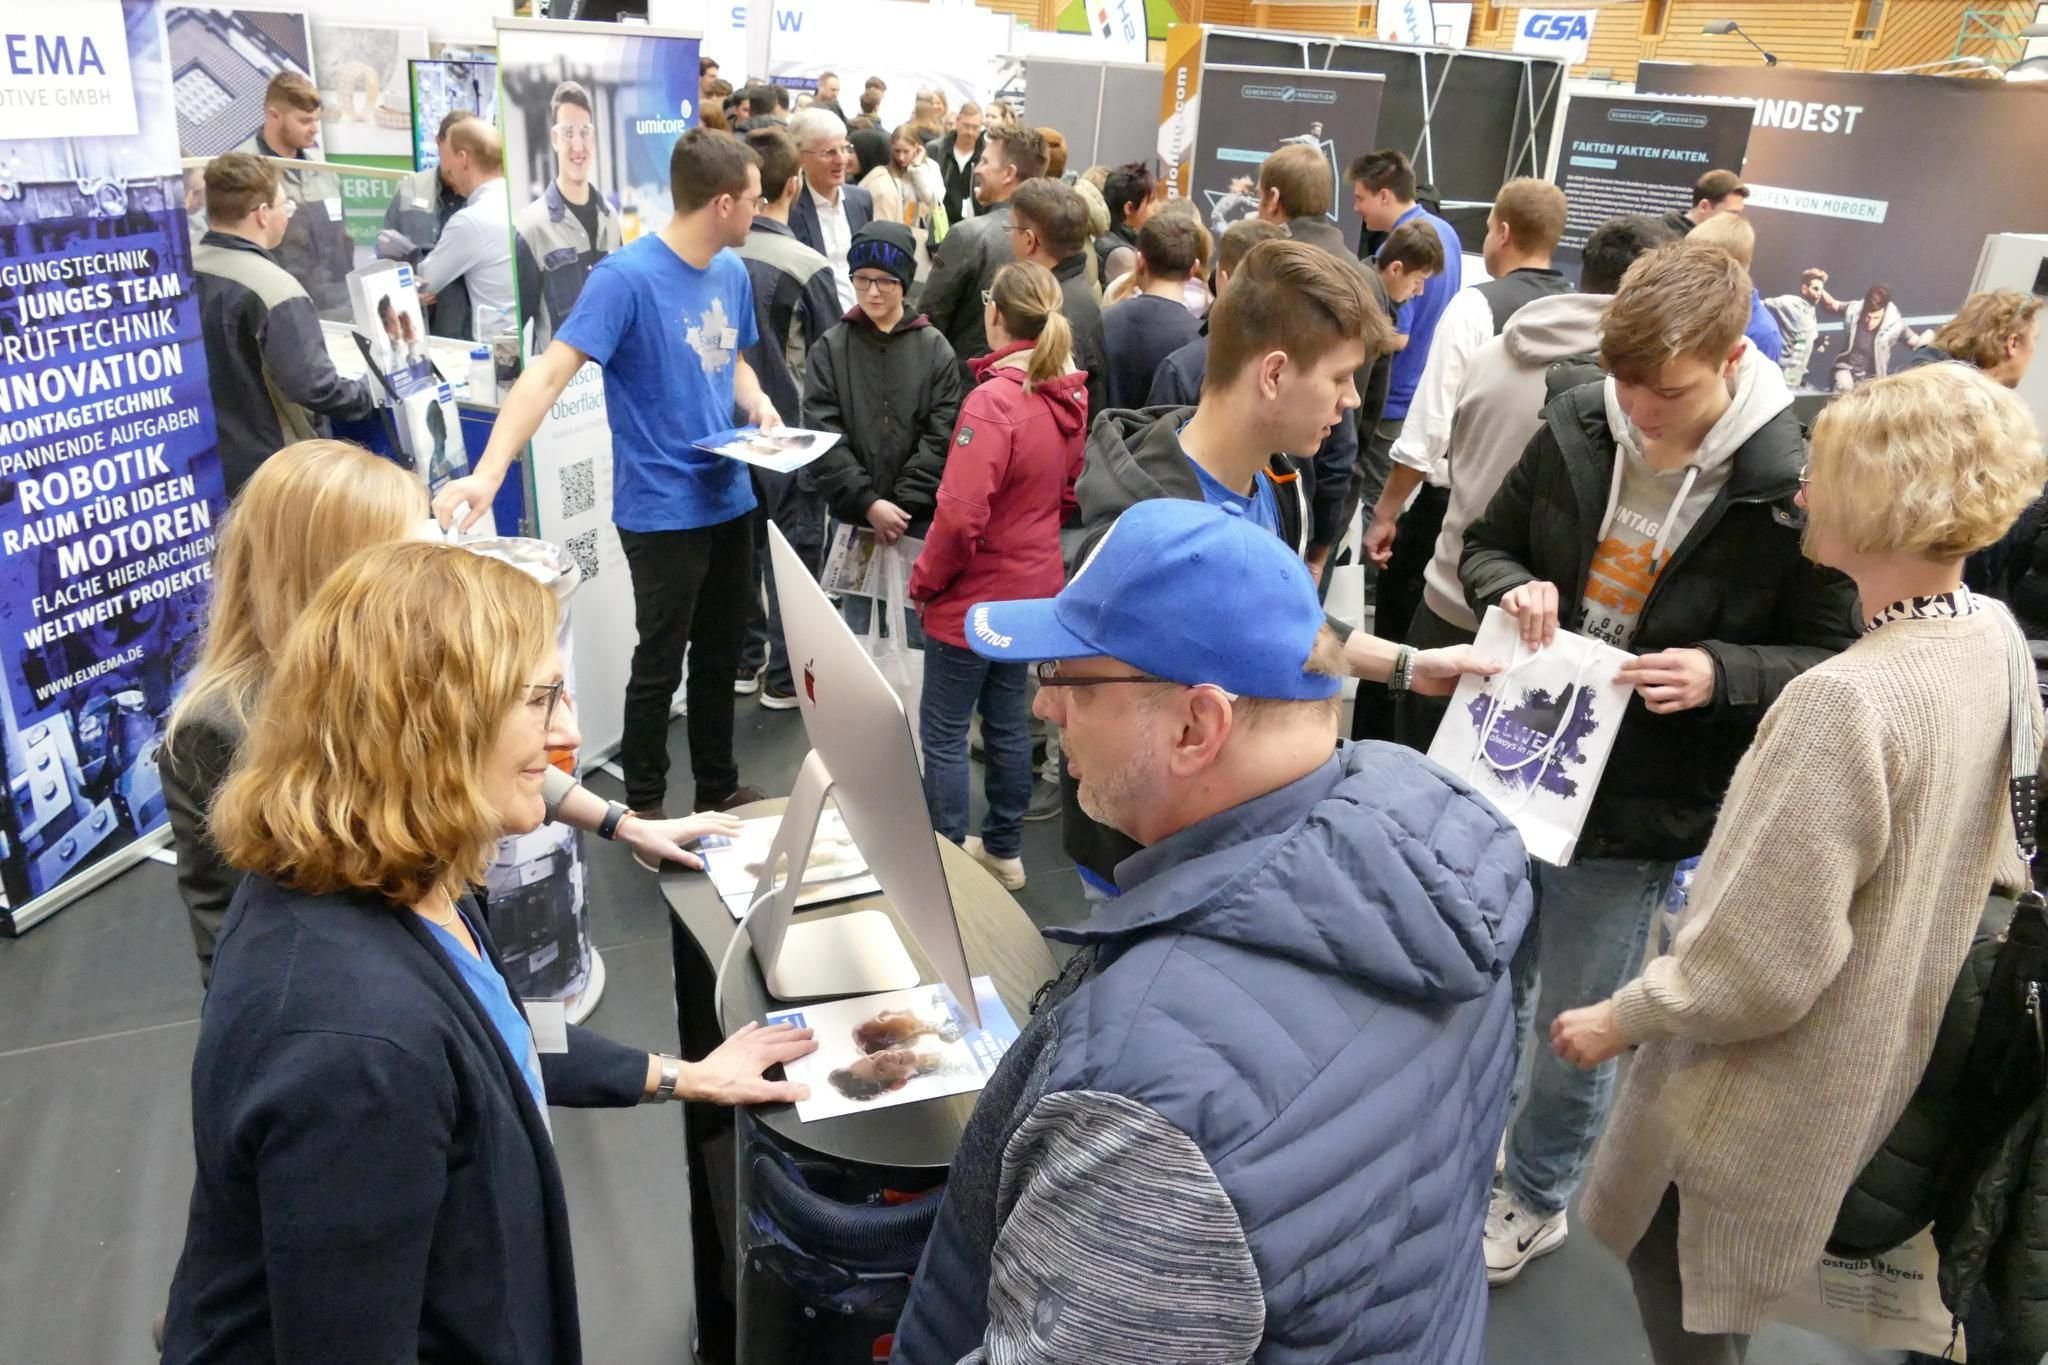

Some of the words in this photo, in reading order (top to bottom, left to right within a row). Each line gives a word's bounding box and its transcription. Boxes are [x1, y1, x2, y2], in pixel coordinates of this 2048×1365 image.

[1523, 14, 1588, 41] GSA
[5, 34, 106, 76] EMA
[0, 88, 49, 107] TIVE
[55, 88, 112, 106] GMBH
[636, 114, 686, 135] umicore
[1572, 141, 1615, 154] FAKTEN
[1616, 144, 1660, 158] FAKTEN
[1662, 148, 1710, 163] FAKTEN.
[1795, 196, 1818, 209] VON
[1823, 199, 1880, 218] MORGEN.
[0, 249, 150, 288] GUNGSTECHNIK
[17, 282, 113, 326] JUNGES
[118, 272, 181, 304] TEAM
[0, 308, 176, 365] RÜFTECHNIK
[0, 431, 106, 478] PANNENDE
[110, 406, 200, 447] AUFGABEN
[18, 443, 170, 515] ROBOTIK
[3, 510, 79, 556] RAUM
[82, 495, 129, 530] FÜR
[131, 474, 195, 513] IDEEN
[1613, 505, 1661, 539] INTAG
[57, 499, 211, 579] MOTOREN
[32, 575, 104, 618] FLACHE
[107, 535, 217, 590] HIERARCHIEN
[23, 595, 124, 650] WELTWEIT
[129, 561, 214, 609] PROJEKTE
[36, 645, 145, 702] WWW.ELWEMA.DE
[1488, 734, 1517, 750] always
[1517, 744, 1527, 754] in
[1887, 1264, 1924, 1281] kreis
